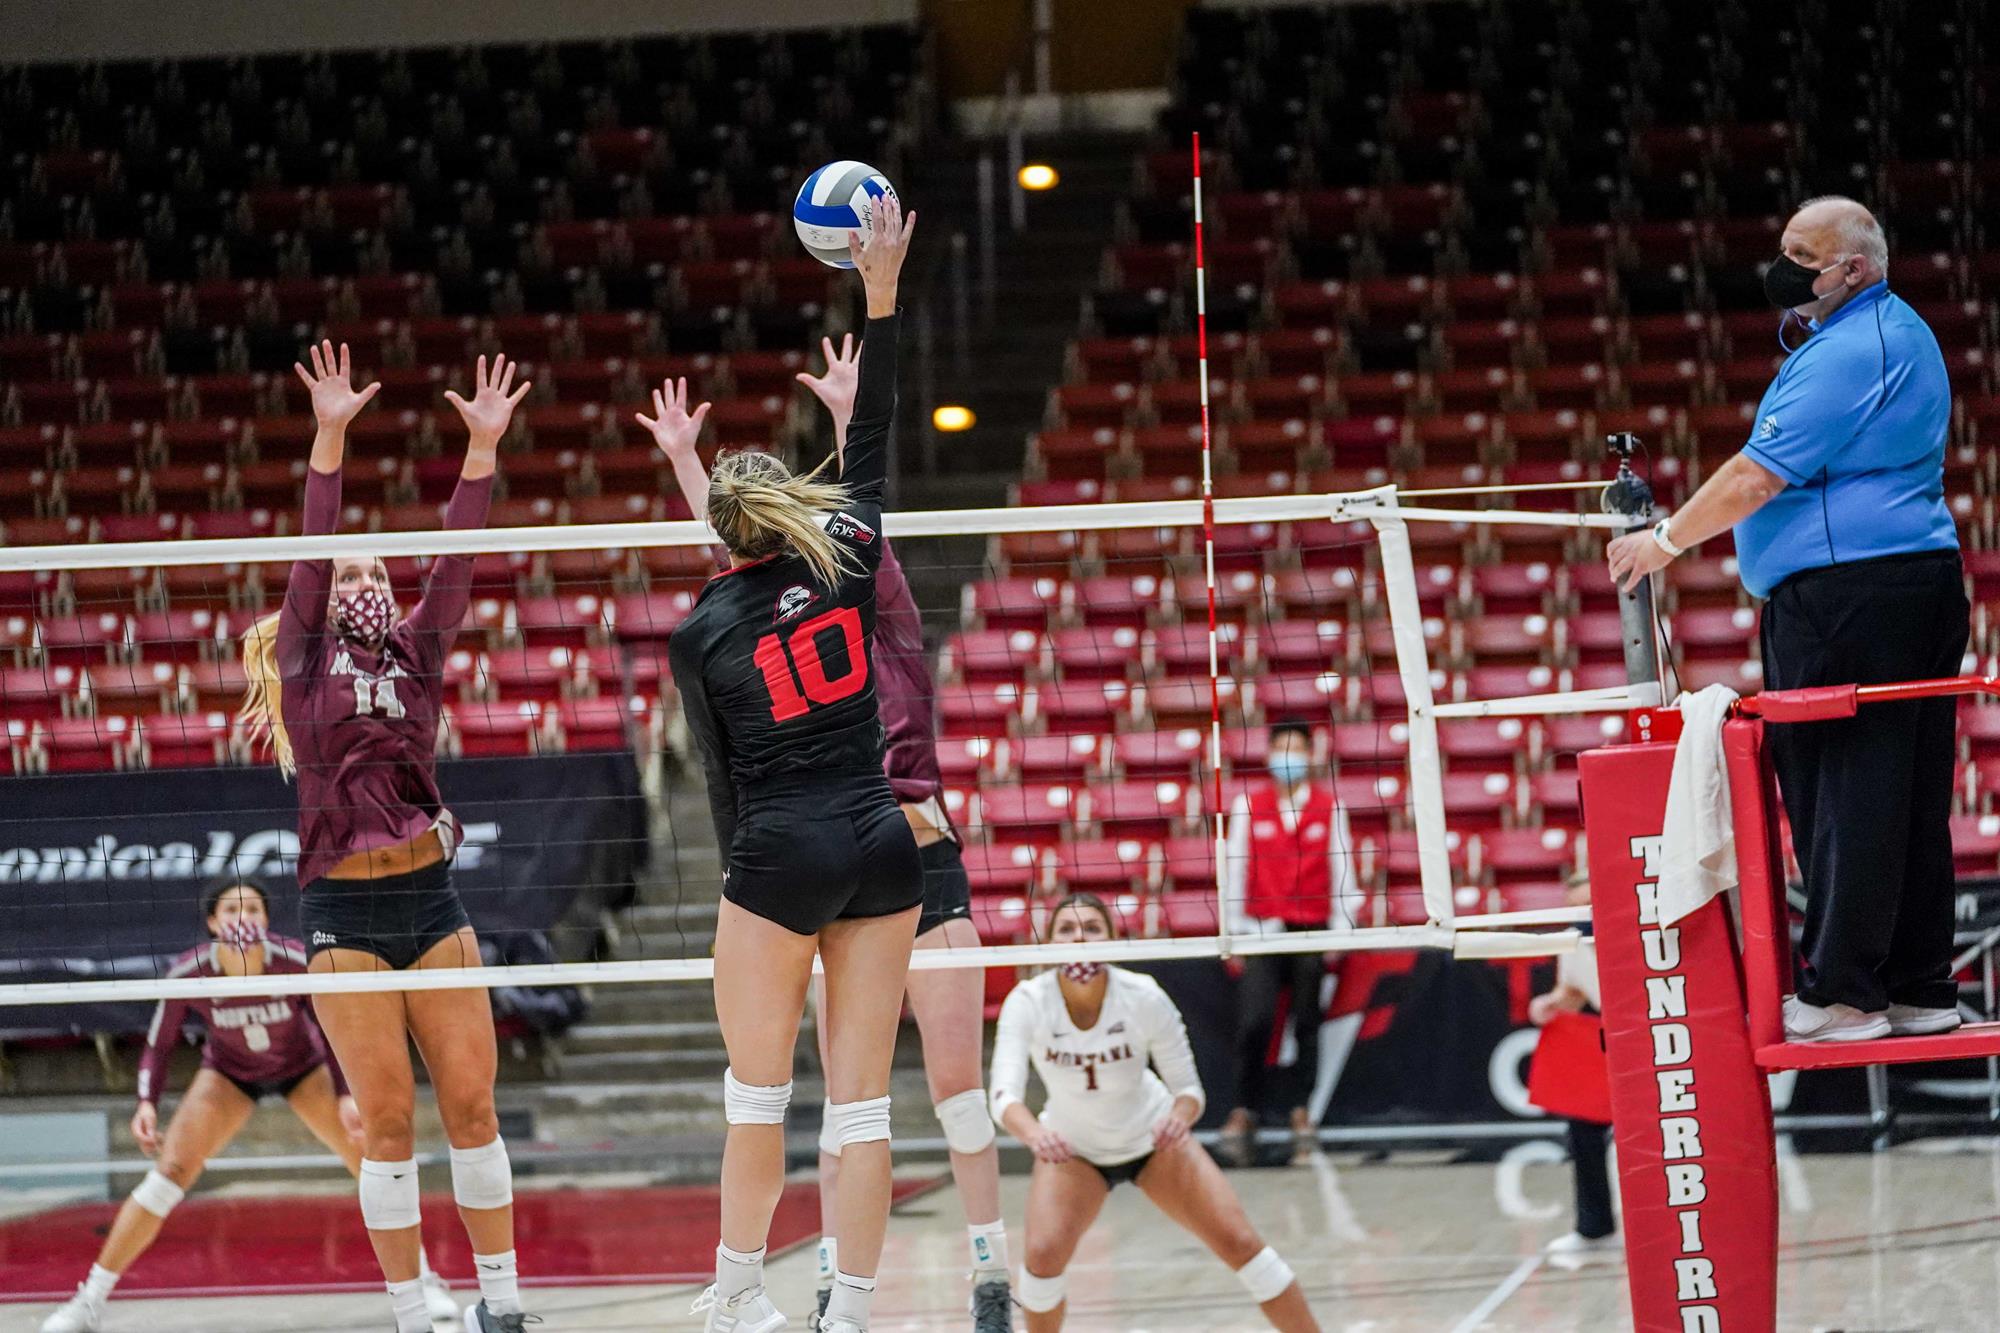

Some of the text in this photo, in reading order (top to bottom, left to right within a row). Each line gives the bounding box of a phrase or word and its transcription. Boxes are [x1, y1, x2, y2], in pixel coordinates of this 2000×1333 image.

[831, 523, 857, 538] SKY
[753, 607, 869, 723] 10
[354, 678, 406, 718] 14
[1084, 1063, 1099, 1091] 1
